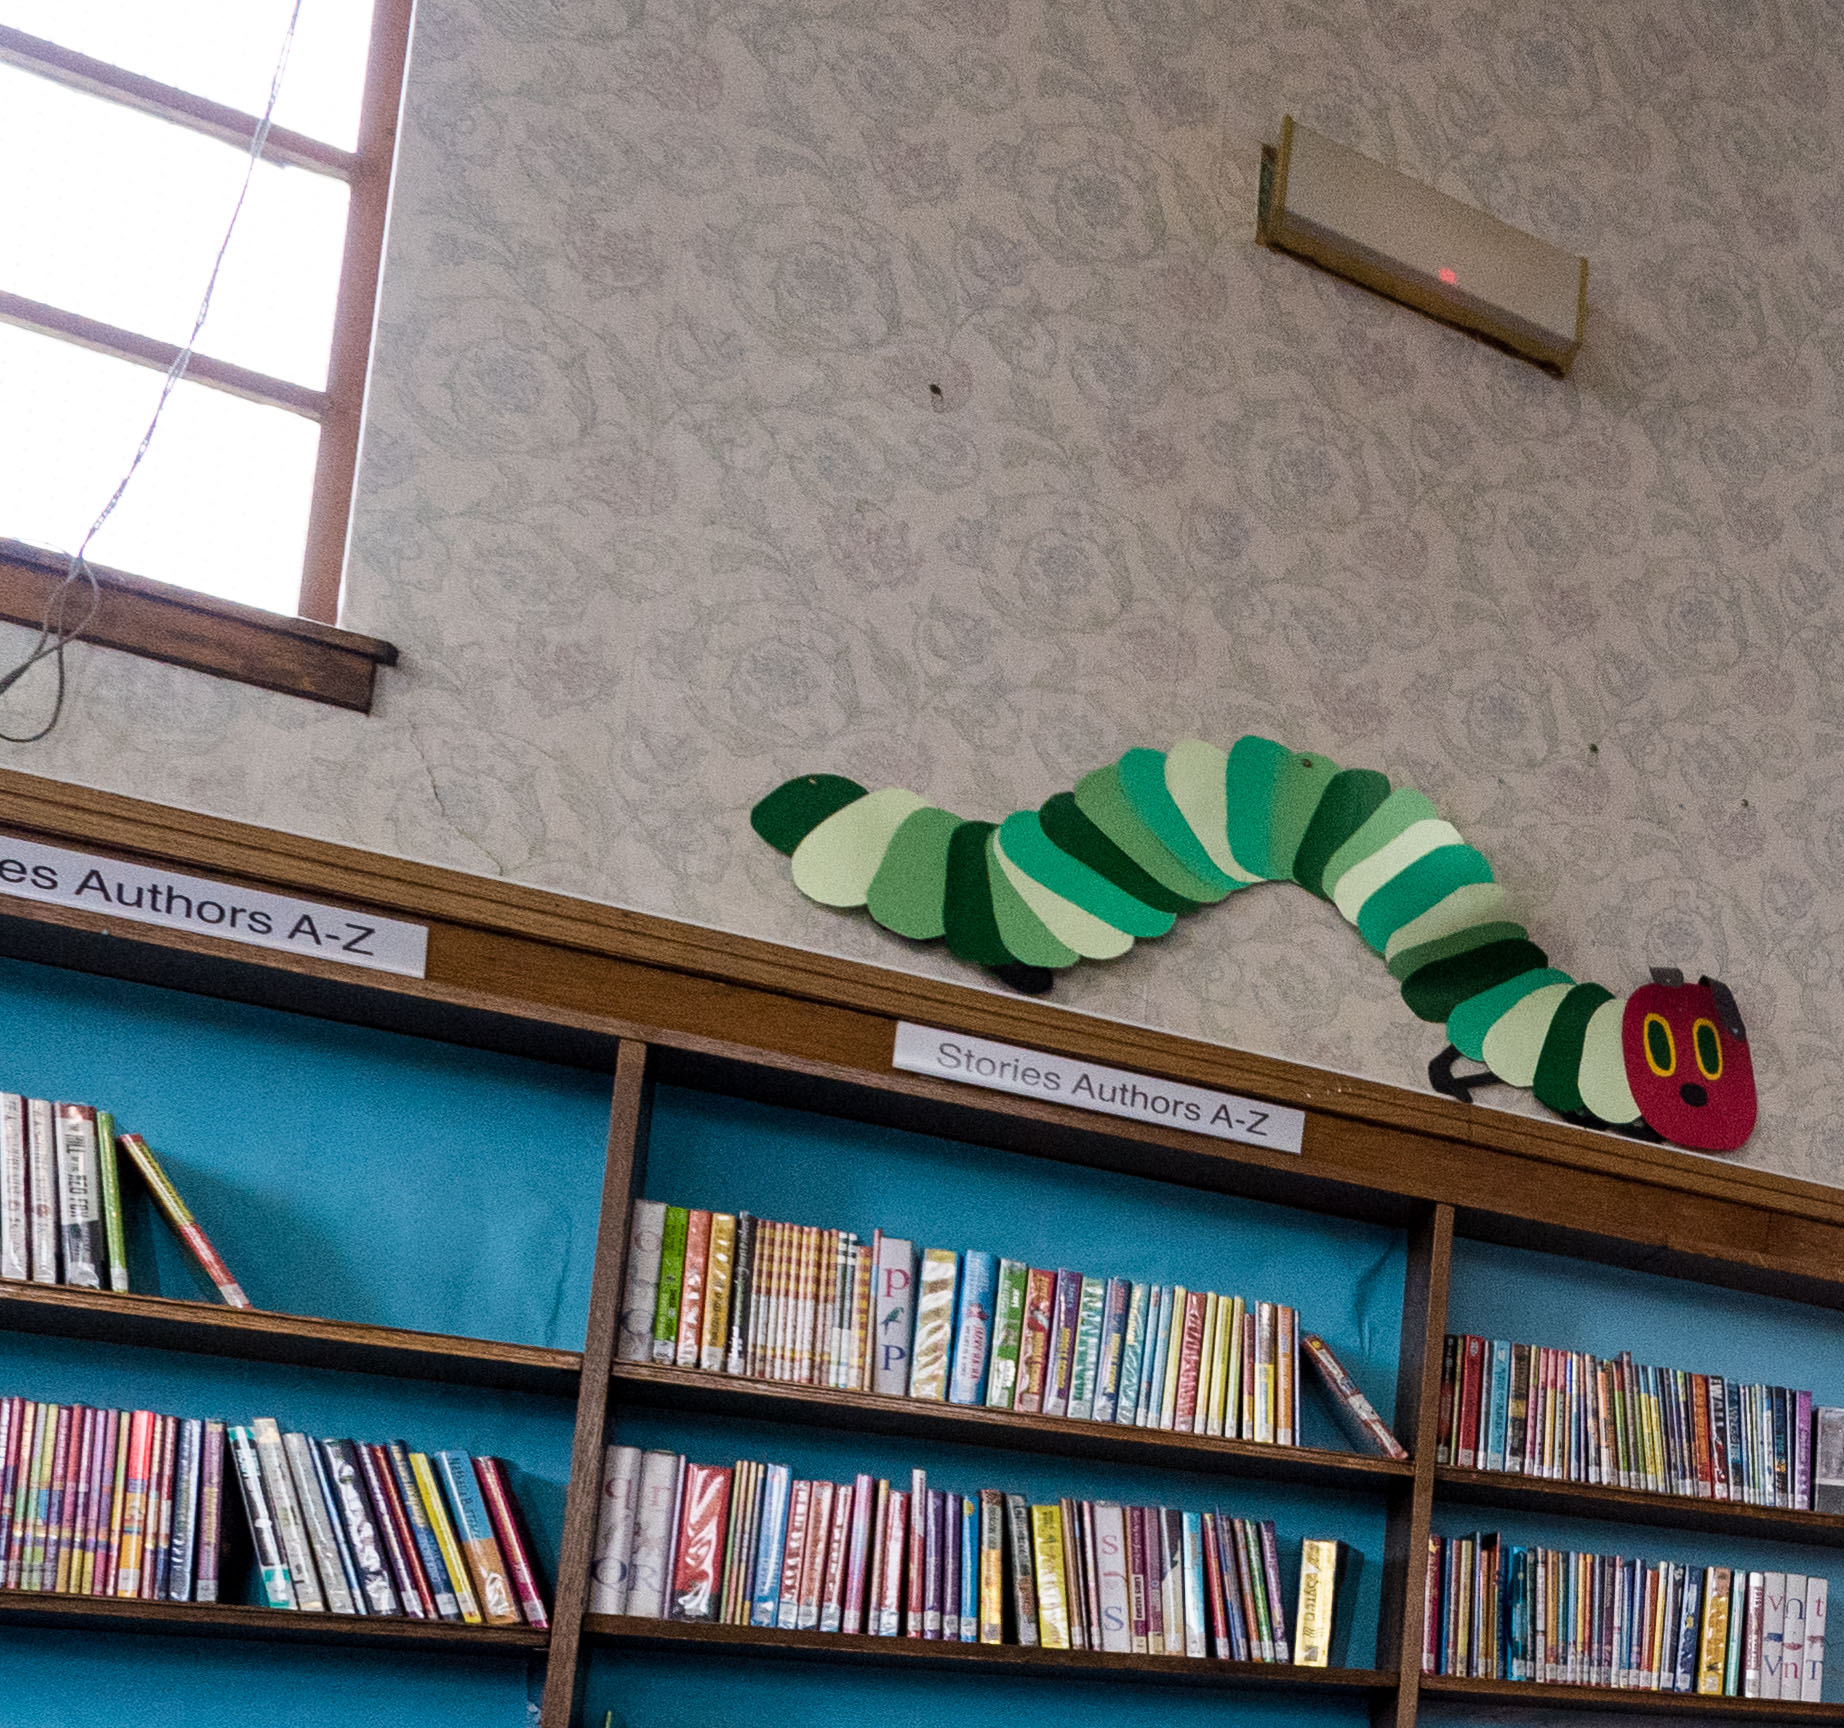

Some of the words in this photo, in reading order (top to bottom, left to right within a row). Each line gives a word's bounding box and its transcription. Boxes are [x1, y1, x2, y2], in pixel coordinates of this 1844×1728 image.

[75, 869, 272, 935] Authors
[288, 914, 376, 956] A-Z
[937, 1042, 1061, 1091] Stories
[1071, 1073, 1201, 1121] Authors
[1210, 1104, 1270, 1137] A-Z
